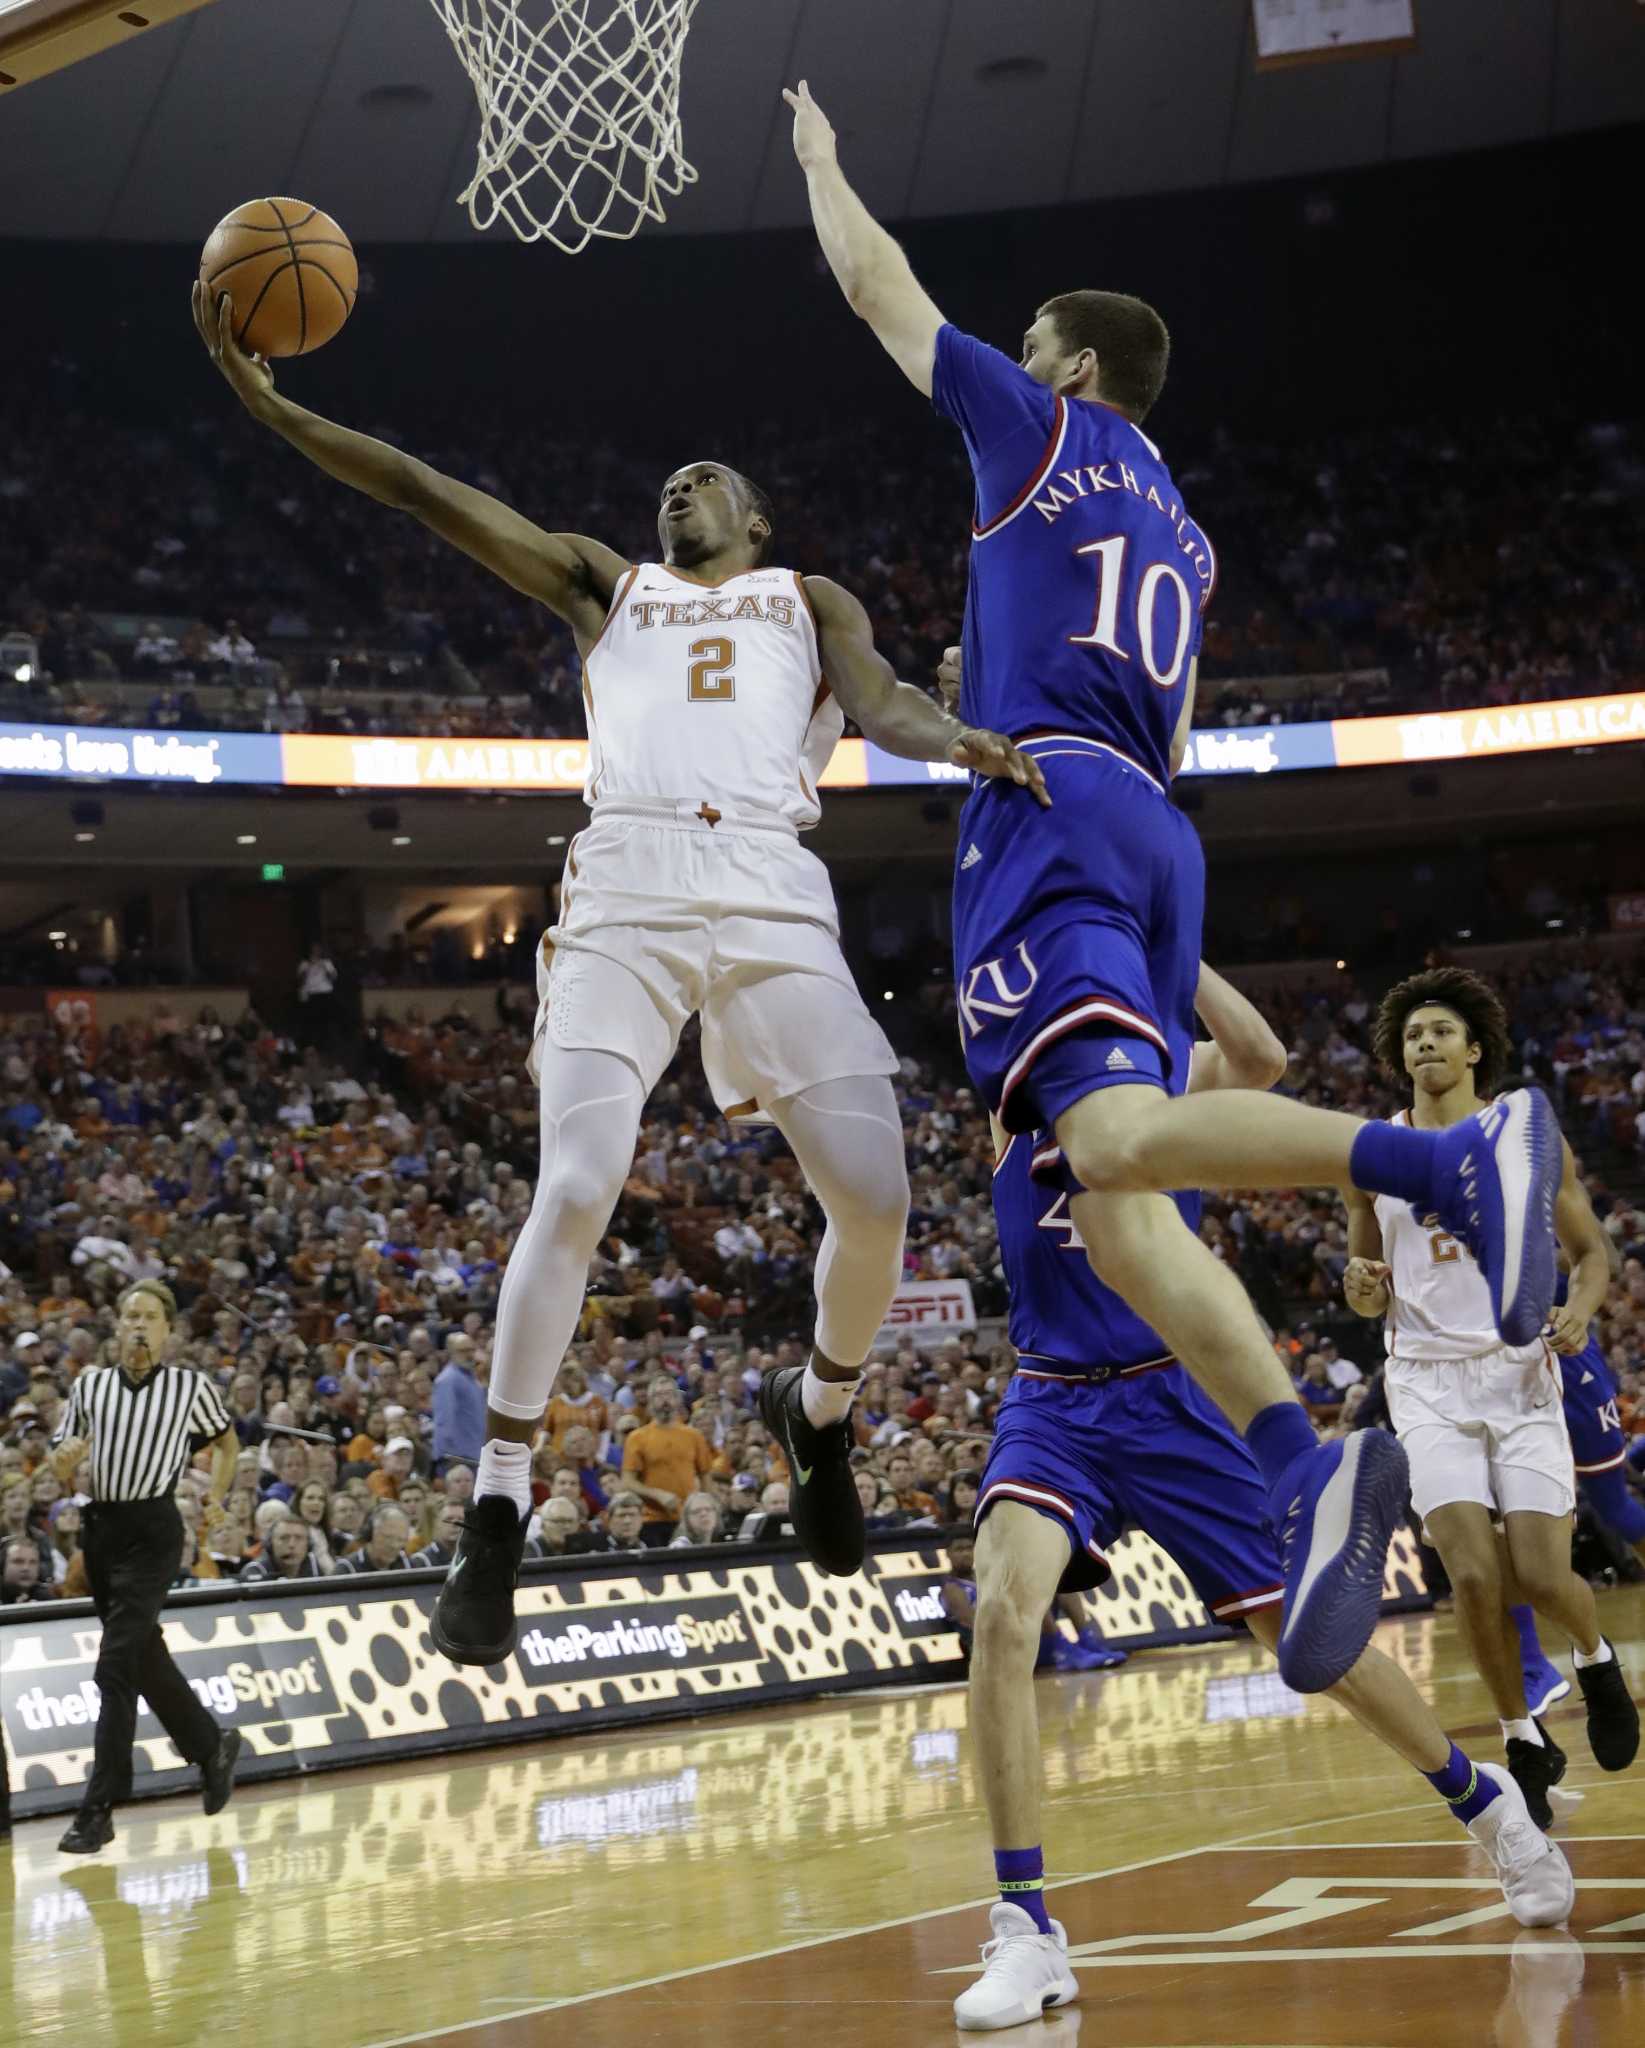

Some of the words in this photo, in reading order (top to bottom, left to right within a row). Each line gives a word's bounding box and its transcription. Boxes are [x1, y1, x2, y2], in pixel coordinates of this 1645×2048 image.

[1032, 461, 1210, 602] MYKHAILIU
[630, 594, 796, 631] TEXAS
[1069, 535, 1193, 688] 10
[687, 635, 736, 702] 2
[959, 937, 1039, 1038] KU
[1038, 1191, 1088, 1249] 4
[882, 1295, 964, 1323] SPN
